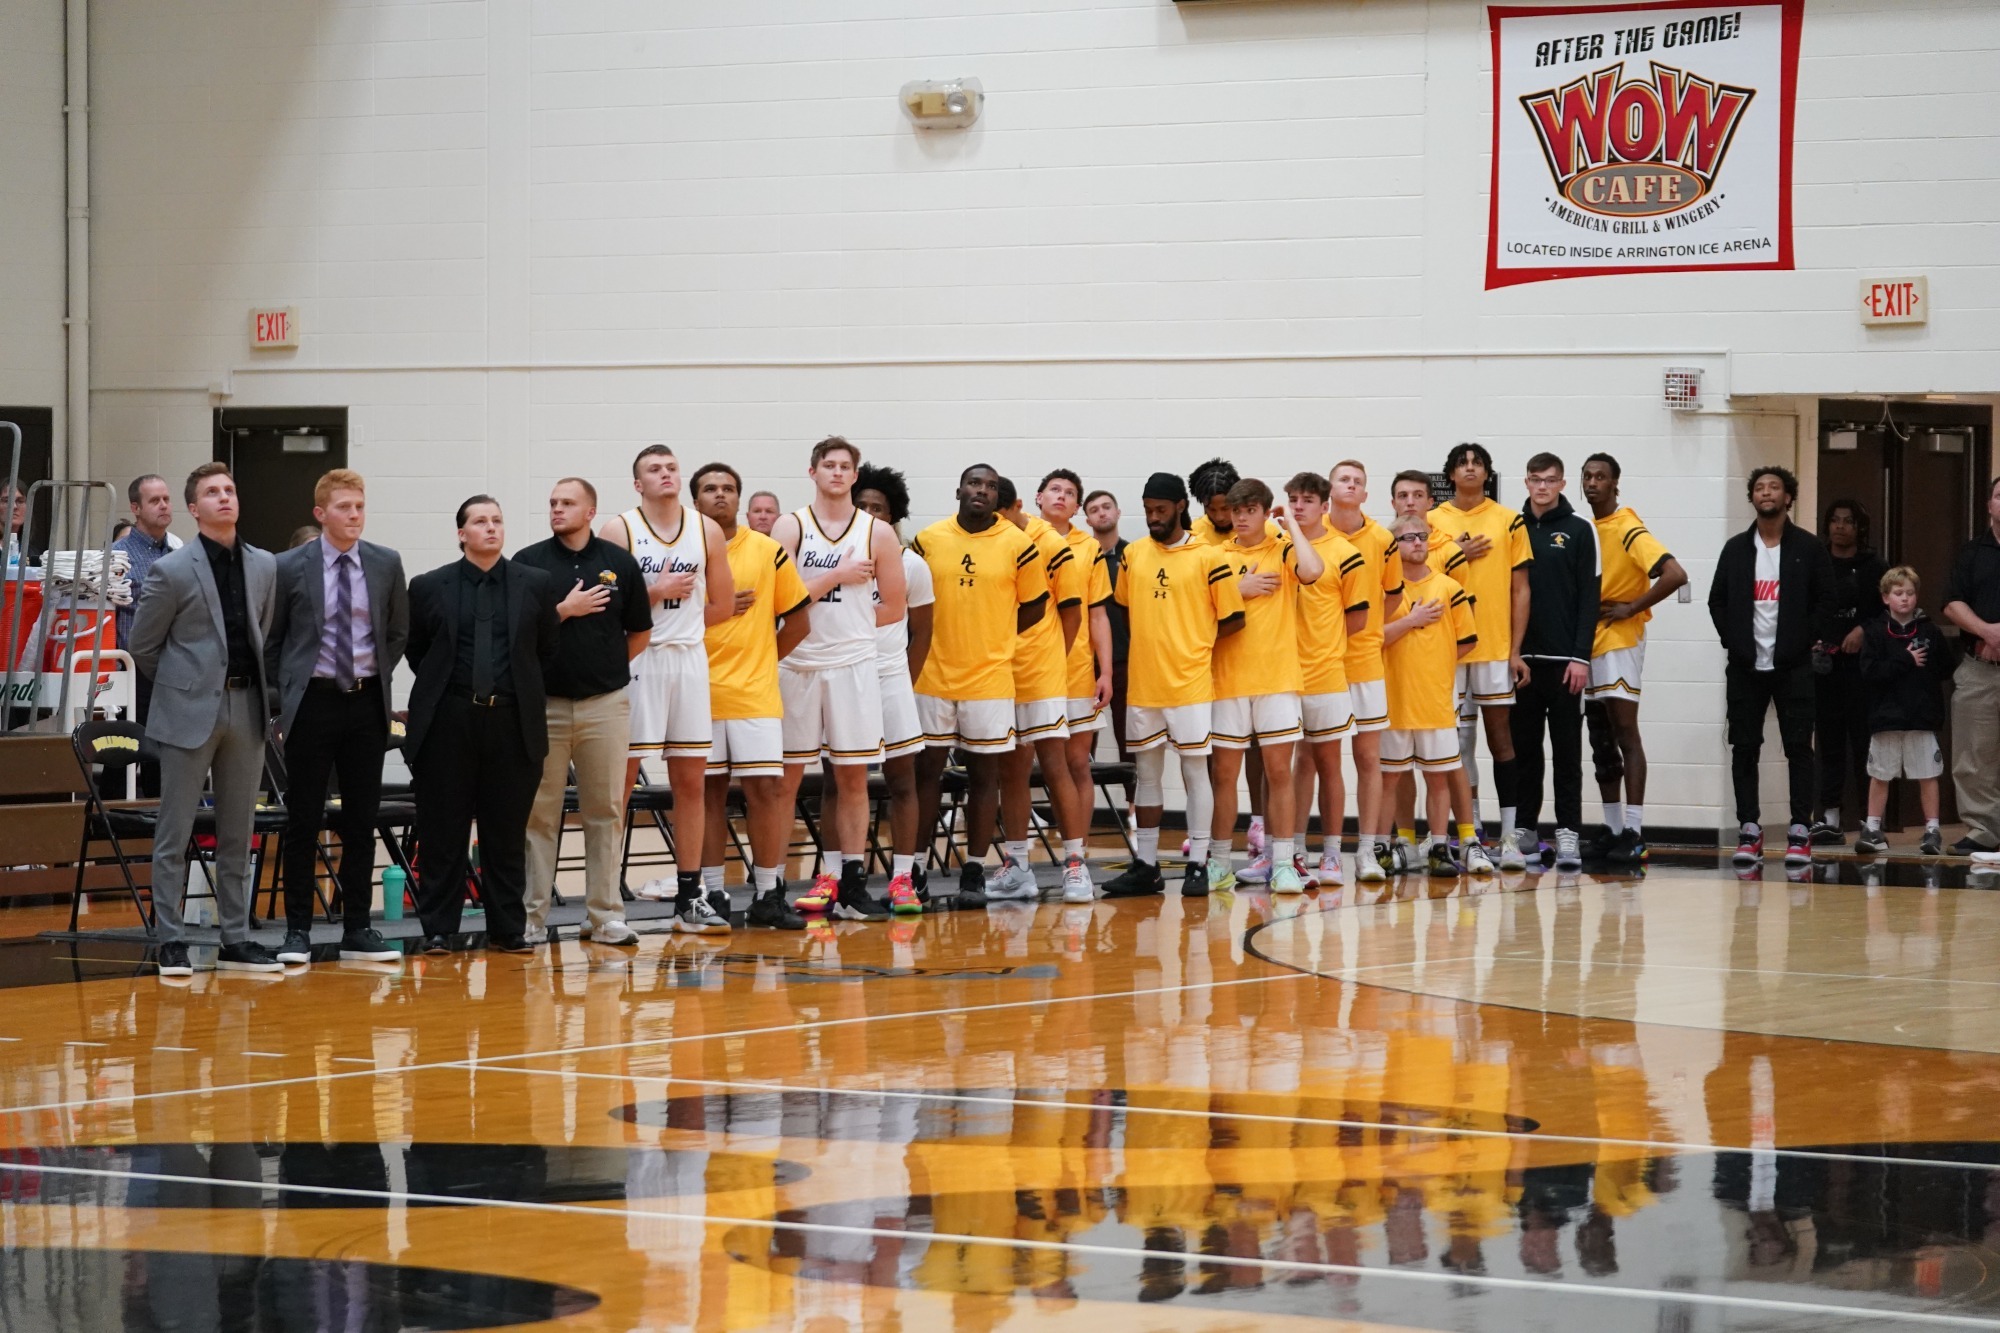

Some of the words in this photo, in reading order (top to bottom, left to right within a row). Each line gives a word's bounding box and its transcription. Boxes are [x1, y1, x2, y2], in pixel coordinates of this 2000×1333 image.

[1535, 33, 1605, 68] AFTER
[1614, 25, 1656, 56] THE
[1662, 11, 1742, 48] GAME!
[1519, 60, 1757, 187] WOW
[1582, 174, 1682, 205] CAFE
[1548, 200, 1610, 233] AMERICAN
[1612, 220, 1649, 235] GRILL
[1652, 220, 1662, 233] &
[1664, 196, 1722, 231] WINGERY
[1507, 241, 1567, 257] LOCATED
[1570, 246, 1613, 258] INSIDE
[1616, 244, 1696, 258] ARRINGTON
[1699, 242, 1719, 255] ICE
[1723, 236, 1772, 253] ARENA
[1871, 282, 1914, 317] EXIT
[257, 311, 287, 342] EXIT
[640, 556, 699, 573] Buldogs
[803, 550, 842, 569] Bulld
[1754, 580, 1779, 601] NIK
